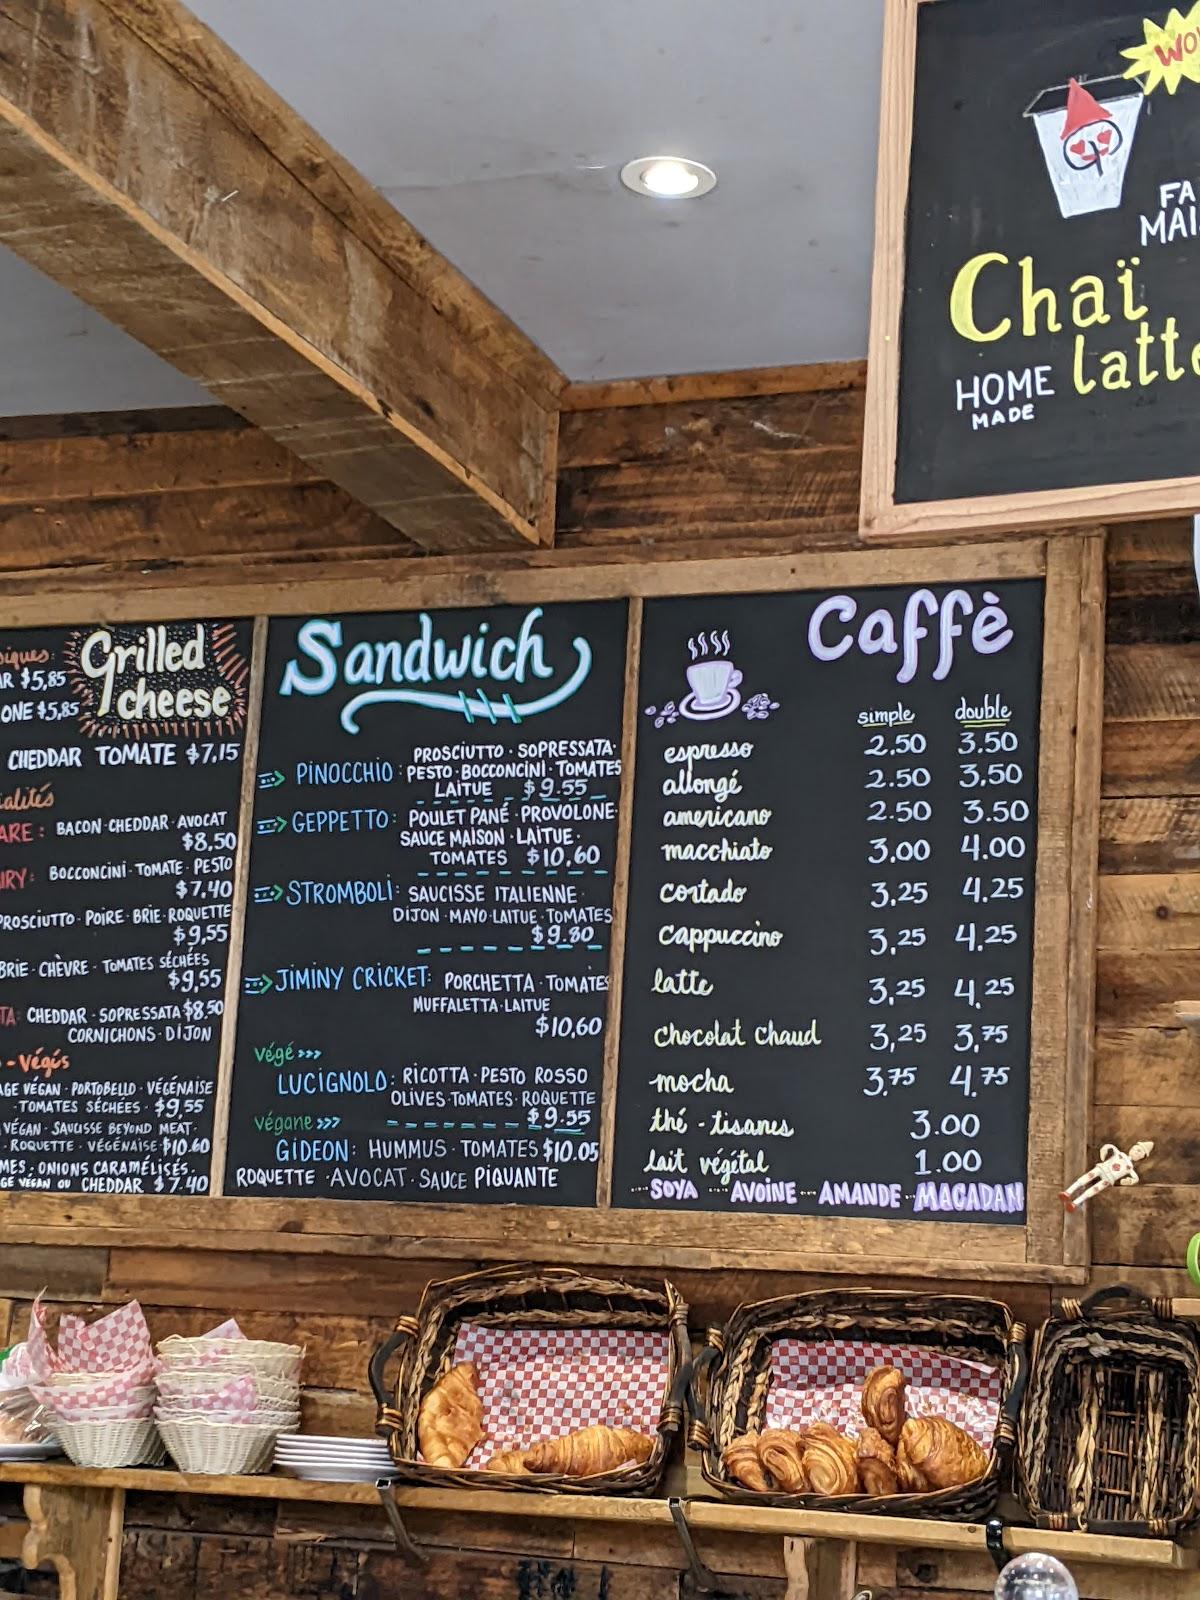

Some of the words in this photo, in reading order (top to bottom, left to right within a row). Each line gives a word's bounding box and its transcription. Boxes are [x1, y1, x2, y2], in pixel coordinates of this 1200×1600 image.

[1154, 26, 1200, 67] WO
[1140, 206, 1200, 246] MAI
[950, 252, 1148, 342] Chaï
[956, 366, 1054, 411] HOME
[972, 404, 1035, 430] MADE
[807, 589, 1014, 683] Caffè
[279, 607, 553, 695] Sandwich
[81, 623, 205, 717] Grilled
[117, 677, 232, 720] cheese
[857, 703, 915, 726] simple
[955, 694, 1012, 720] double
[1, 701, 34, 723] ONE
[8, 747, 82, 771] CHEDDAR
[95, 743, 176, 766] TOMATE
[414, 741, 504, 763] PROSCIUTTO
[518, 739, 613, 758] SOPRESSATA
[664, 741, 754, 770] espresso
[407, 764, 452, 781] PESTO
[461, 760, 546, 779] BOCCONCINI
[556, 760, 622, 778] TOMATES
[435, 780, 493, 798] LAITUE
[662, 768, 743, 802] allongé
[57, 818, 101, 836] BACON
[108, 815, 169, 833] CHEDDAR
[177, 812, 227, 829] AVOCAT
[408, 809, 464, 828] POULET
[470, 802, 510, 825] PANÉ
[520, 802, 615, 823] PROVOLONE
[663, 806, 772, 828] americano
[400, 830, 446, 847] SAUCE
[450, 826, 505, 847] MAISON
[516, 825, 573, 846] LAITUE
[429, 850, 508, 866] TOMATES
[660, 837, 774, 863] macchiato
[49, 861, 127, 881] BOCCONCINI
[135, 860, 183, 876] TOMATE
[194, 856, 233, 875] PESTO
[408, 884, 485, 903] SAUCISSE
[495, 884, 578, 904] ITALIENNE
[659, 878, 747, 904] cortado
[85, 907, 125, 926] POIRE
[133, 905, 161, 924] BRIE
[168, 904, 232, 924] ROQUETTE
[393, 906, 440, 924] DIJON
[449, 907, 487, 923] MAYO
[493, 907, 538, 924] LAITUE
[545, 907, 613, 924] TOMATES
[658, 920, 784, 953] cappuccino
[39, 954, 89, 978] CHÈVRE
[102, 957, 154, 974] TOMATES
[159, 947, 210, 969] SÉCHÉES
[276, 963, 345, 992] JIMINY
[444, 971, 535, 993] PORCHETTA
[651, 968, 714, 996] latte
[27, 1007, 87, 1025] CHEDDAR
[99, 1005, 181, 1023] SOPRESSATA
[413, 997, 499, 1013] MUFFALETTA
[504, 996, 551, 1013] LAITUE
[68, 1026, 156, 1043] CORNICHONS
[165, 1023, 212, 1042] DIJON
[254, 1041, 294, 1067] végé
[23, 1076, 61, 1096] VÉGAN
[71, 1081, 136, 1096] PORTOBELLO
[147, 1075, 213, 1095] VÉGÉNAISE
[402, 1063, 470, 1085] RICOTTA
[481, 1067, 526, 1084] PESTO
[534, 1067, 588, 1085] ROSSO
[649, 1067, 734, 1094] mocha
[19, 1100, 78, 1113] TOMATES
[86, 1097, 140, 1114] SÉCHÉES
[391, 1089, 446, 1107] OLIVES
[450, 1090, 513, 1107] TOMATES
[521, 1090, 596, 1107] ROQUETTE
[3, 1118, 41, 1136] VÉGAN
[51, 1121, 102, 1136] SAUCISSE
[108, 1122, 152, 1136] BEYOND
[159, 1120, 193, 1135] MEAT
[254, 1112, 313, 1136] végane
[649, 1107, 687, 1134] thé
[710, 1112, 795, 1137] tisanes
[10, 1138, 74, 1152] ROQUETTE
[87, 1136, 157, 1152] VÉGÉNAISE
[368, 1139, 447, 1160] HUMMUS
[460, 1139, 539, 1158] TOMATES
[38, 1161, 89, 1177] ONIONS
[93, 1157, 189, 1177] CARAMÉLISÉS
[236, 1168, 315, 1187] ROQUETTE
[330, 1167, 407, 1188] AVOCAT
[419, 1171, 467, 1190] SAUCE
[474, 1164, 560, 1189] PIQUANTE
[643, 1149, 688, 1174] lait
[699, 1147, 769, 1184] végétal
[18, 1174, 51, 1188] VÉGAN
[57, 1178, 71, 1188] OU
[81, 1177, 144, 1193] CHEDDAR
[650, 1178, 699, 1200] SOYA
[731, 1177, 797, 1203] AVOINE
[818, 1180, 902, 1208] AMANDE
[913, 1181, 1025, 1213] MACADAN
